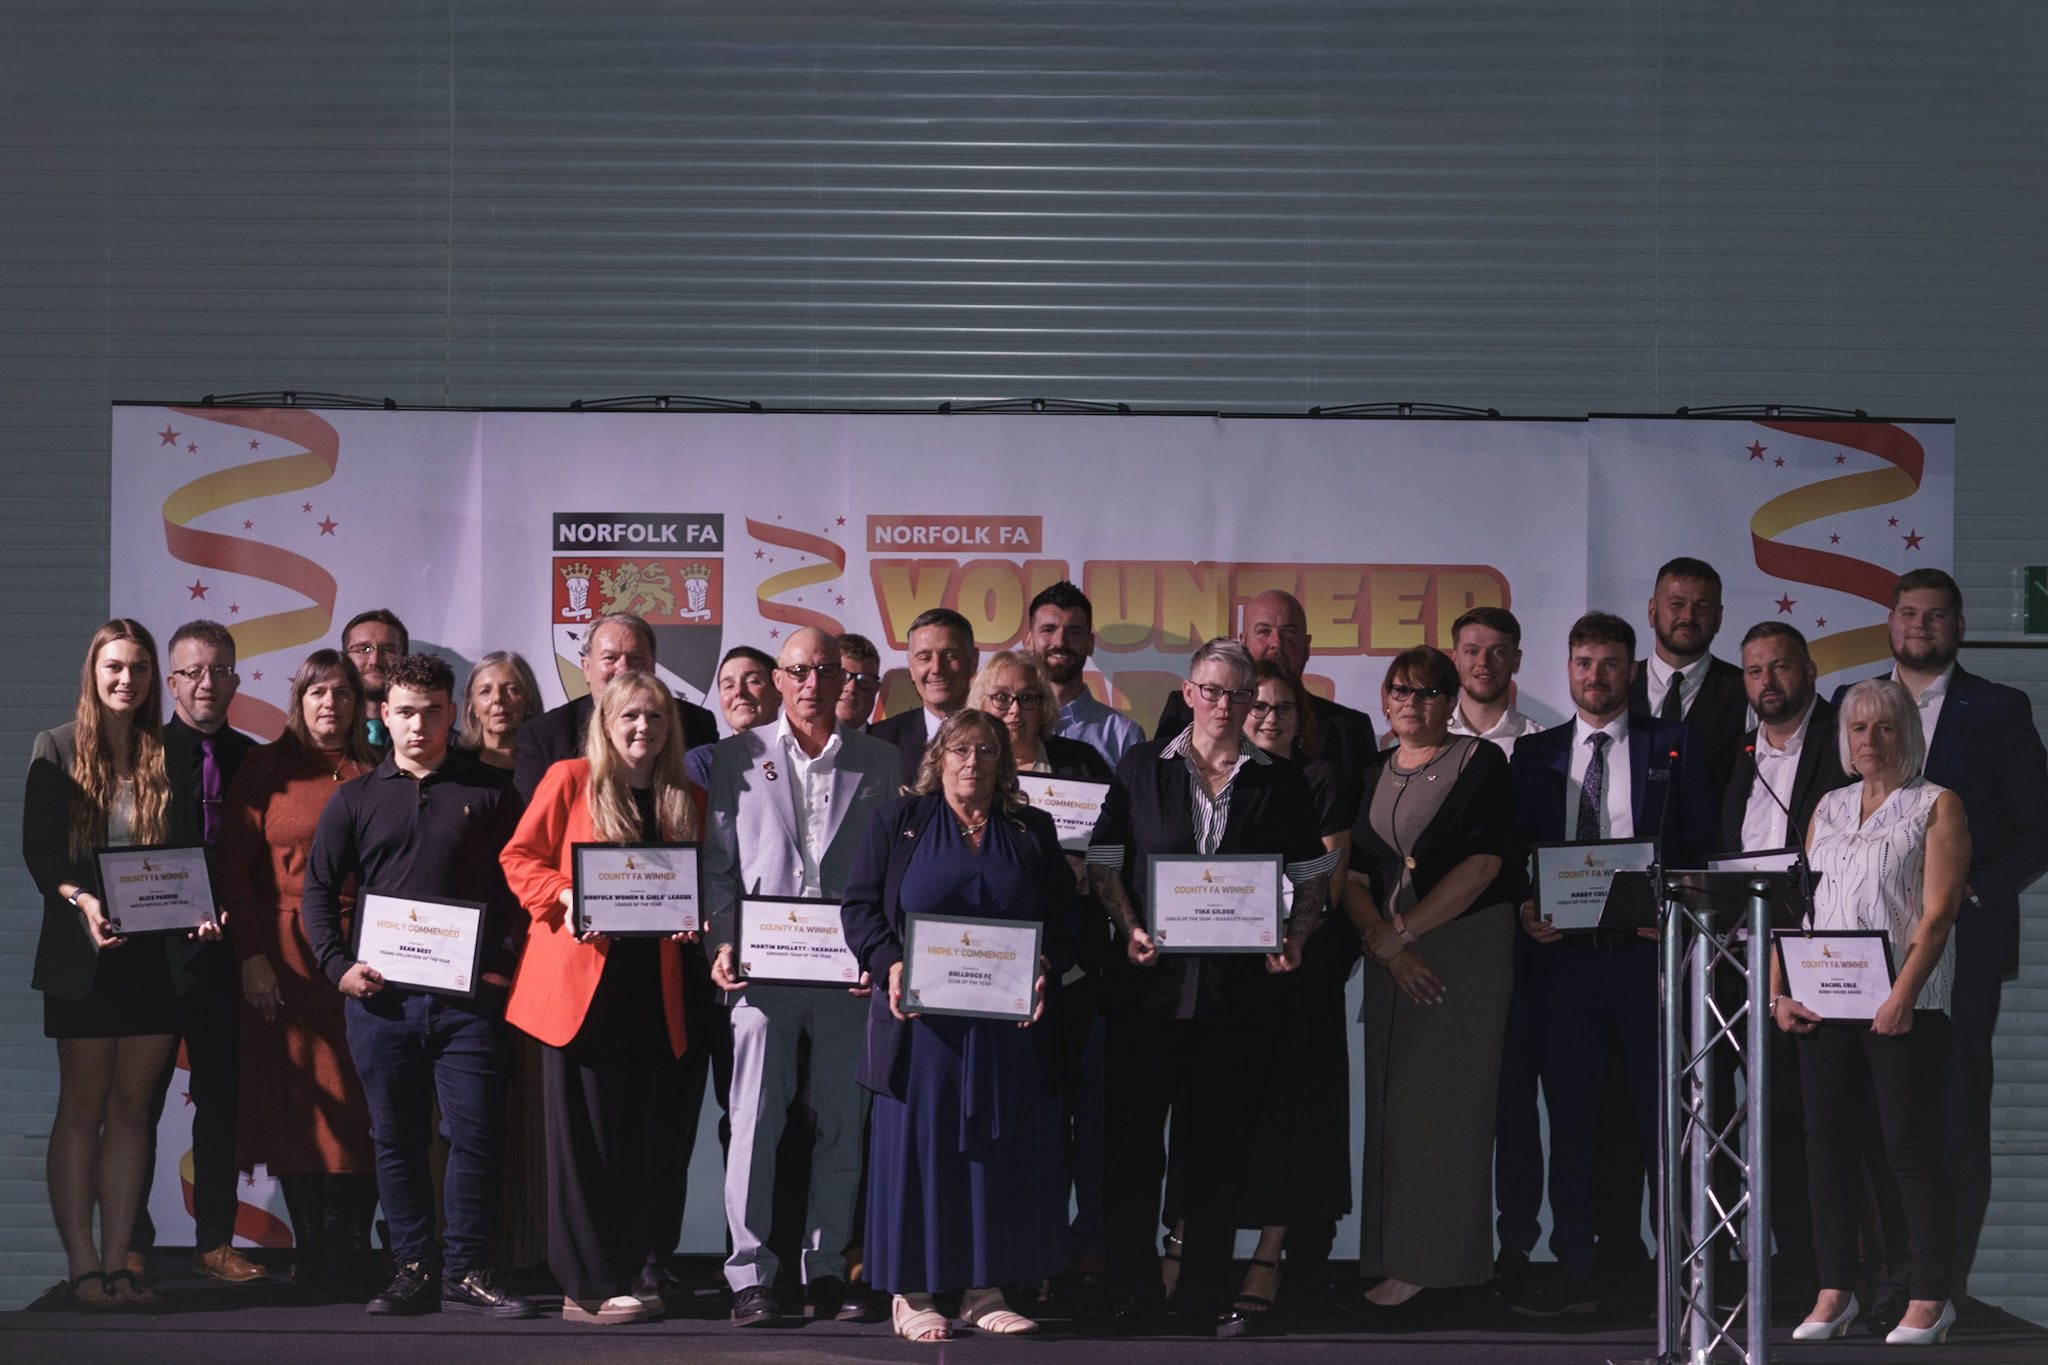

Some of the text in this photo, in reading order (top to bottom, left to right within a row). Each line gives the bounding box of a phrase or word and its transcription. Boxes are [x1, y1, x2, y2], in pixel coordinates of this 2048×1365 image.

[559, 523, 718, 543] NORFOLK FA
[875, 525, 1030, 544] NORFOLK FA
[1045, 799, 1098, 811] COMMENDED
[120, 871, 190, 884] COUNTY FA WINNER
[598, 873, 631, 881] COUNTY
[644, 872, 677, 880] WINNER
[1558, 870, 1590, 879] COUNTY
[1592, 870, 1602, 878] FA
[1174, 886, 1256, 894] COUNTY FA WINNER
[377, 920, 460, 938] HIGHLY COMMENDED
[760, 924, 839, 934] COUNTY FA WINNER
[928, 946, 1016, 960] HIGHLY COMMENDED
[948, 970, 982, 979] BULLDOGS
